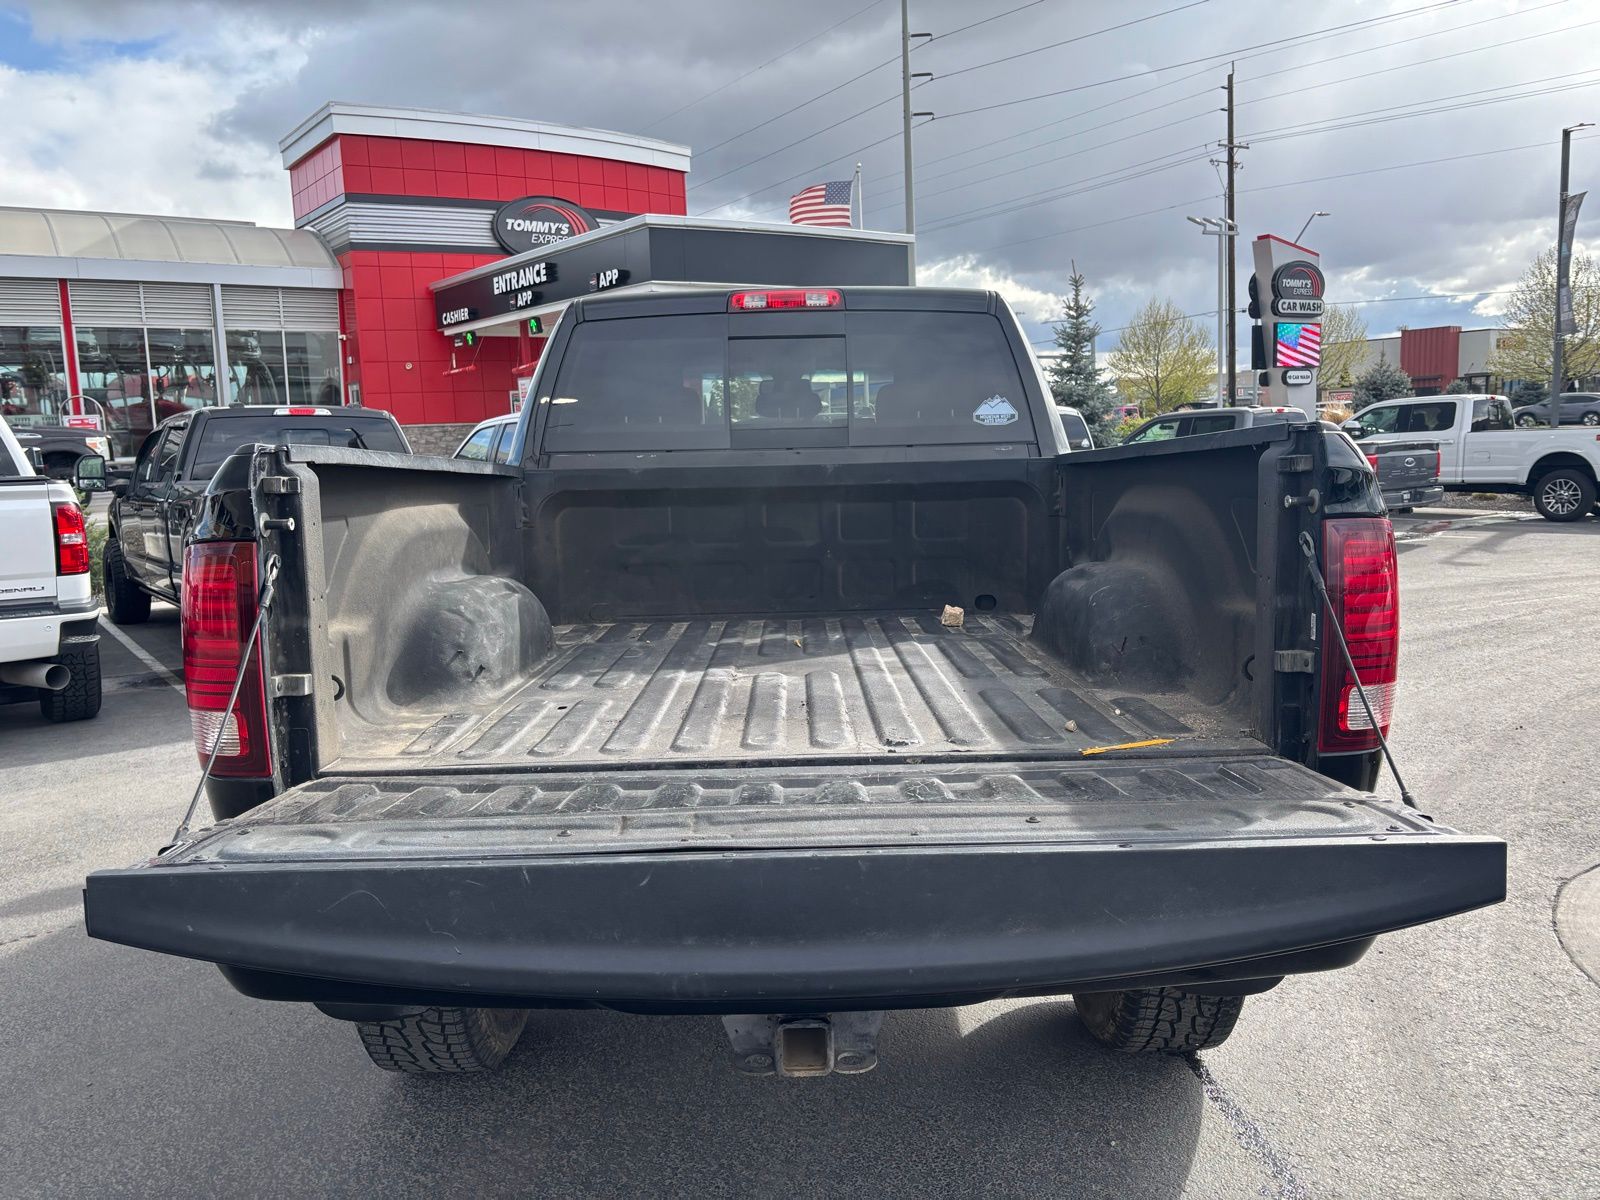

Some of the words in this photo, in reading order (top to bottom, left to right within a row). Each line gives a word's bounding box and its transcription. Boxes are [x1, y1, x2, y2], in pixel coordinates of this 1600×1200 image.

[505, 218, 570, 235] TOMMY'S
[531, 233, 570, 244] EXPRE
[493, 263, 547, 295] ENTRANCE
[599, 268, 619, 289] APP
[1282, 279, 1312, 288] TOMMY'S
[516, 290, 533, 307] APP
[1293, 287, 1313, 296] EXPRESS
[1281, 301, 1298, 311] CAR
[1299, 301, 1322, 312] WASH
[442, 307, 470, 325] CASHIER
